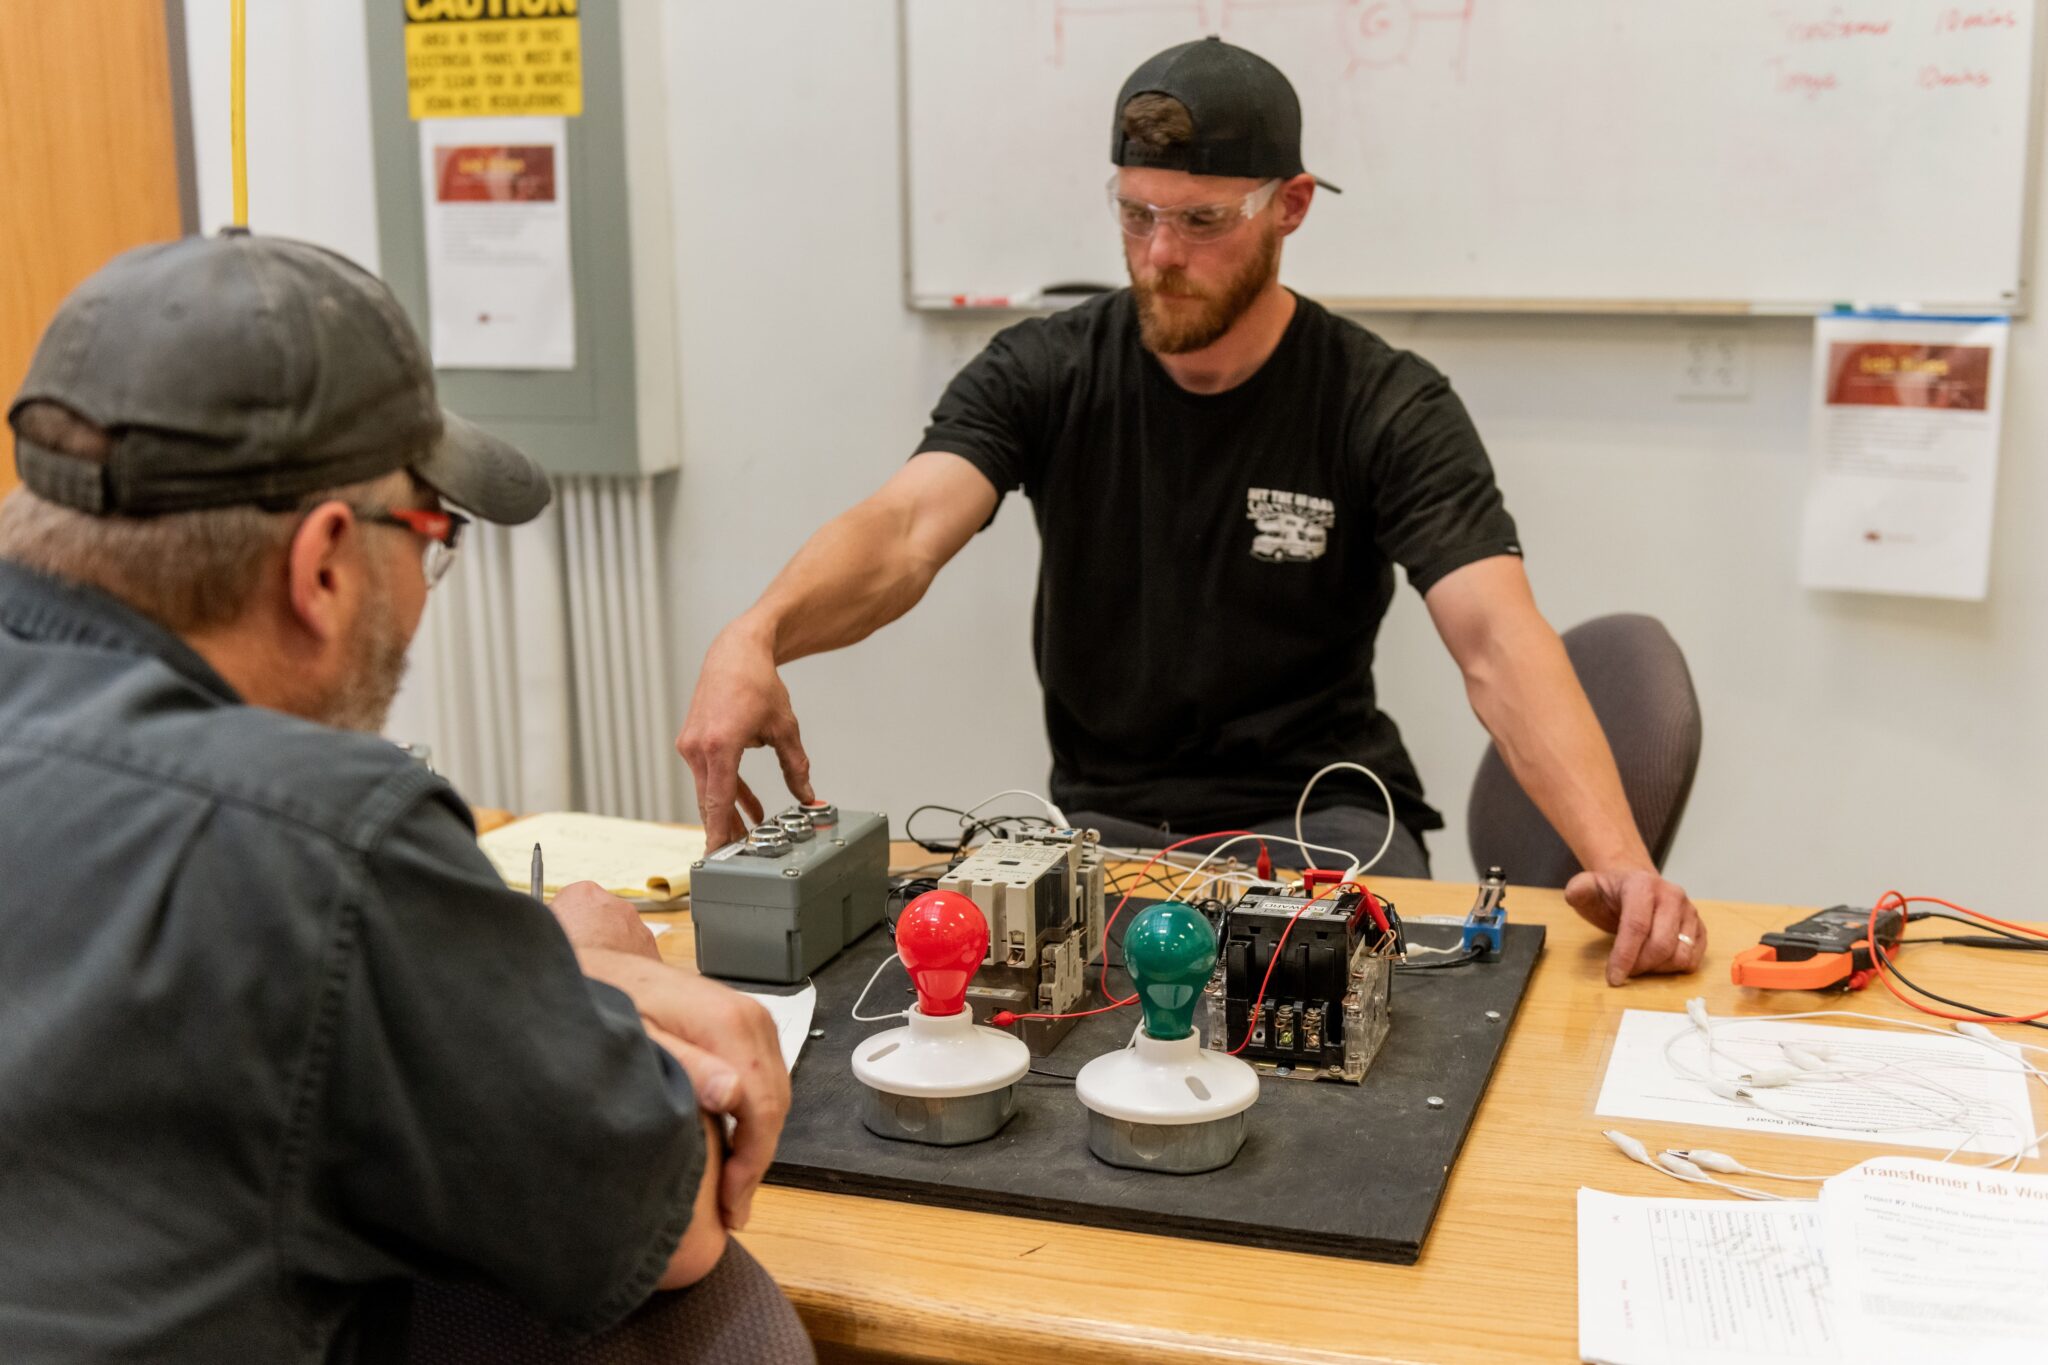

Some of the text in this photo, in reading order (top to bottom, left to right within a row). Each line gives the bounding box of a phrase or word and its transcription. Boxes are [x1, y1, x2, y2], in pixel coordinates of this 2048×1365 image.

[406, 0, 576, 21] CAUTION
[1264, 903, 1325, 912] FOWARD
[1861, 1165, 1969, 1191] Transformer
[1976, 1181, 2008, 1196] Lab
